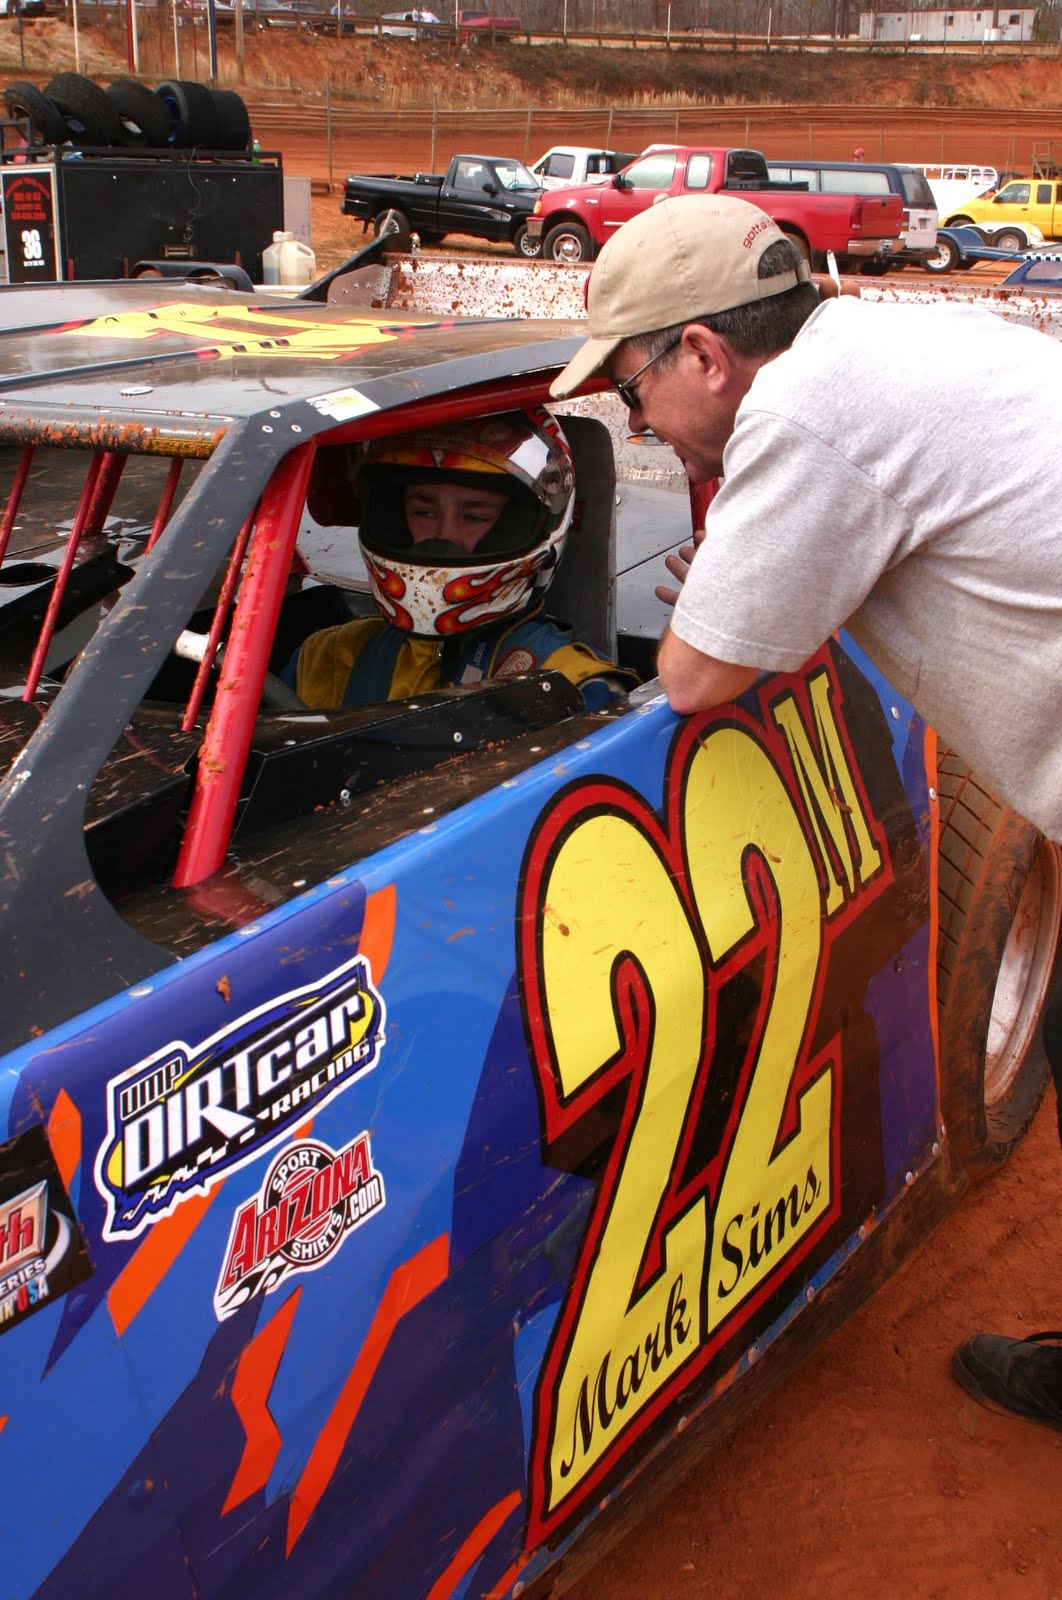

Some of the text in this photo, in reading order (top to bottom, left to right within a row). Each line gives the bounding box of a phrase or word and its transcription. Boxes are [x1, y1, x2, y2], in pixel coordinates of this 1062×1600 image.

[743, 222, 768, 249] gotta
[221, 1139, 371, 1292] ARIZONA
[272, 1151, 321, 1194] SPORT
[291, 1211, 343, 1259] SHIRTS
[718, 1164, 822, 1300] Sims
[560, 1272, 692, 1480] Mark
